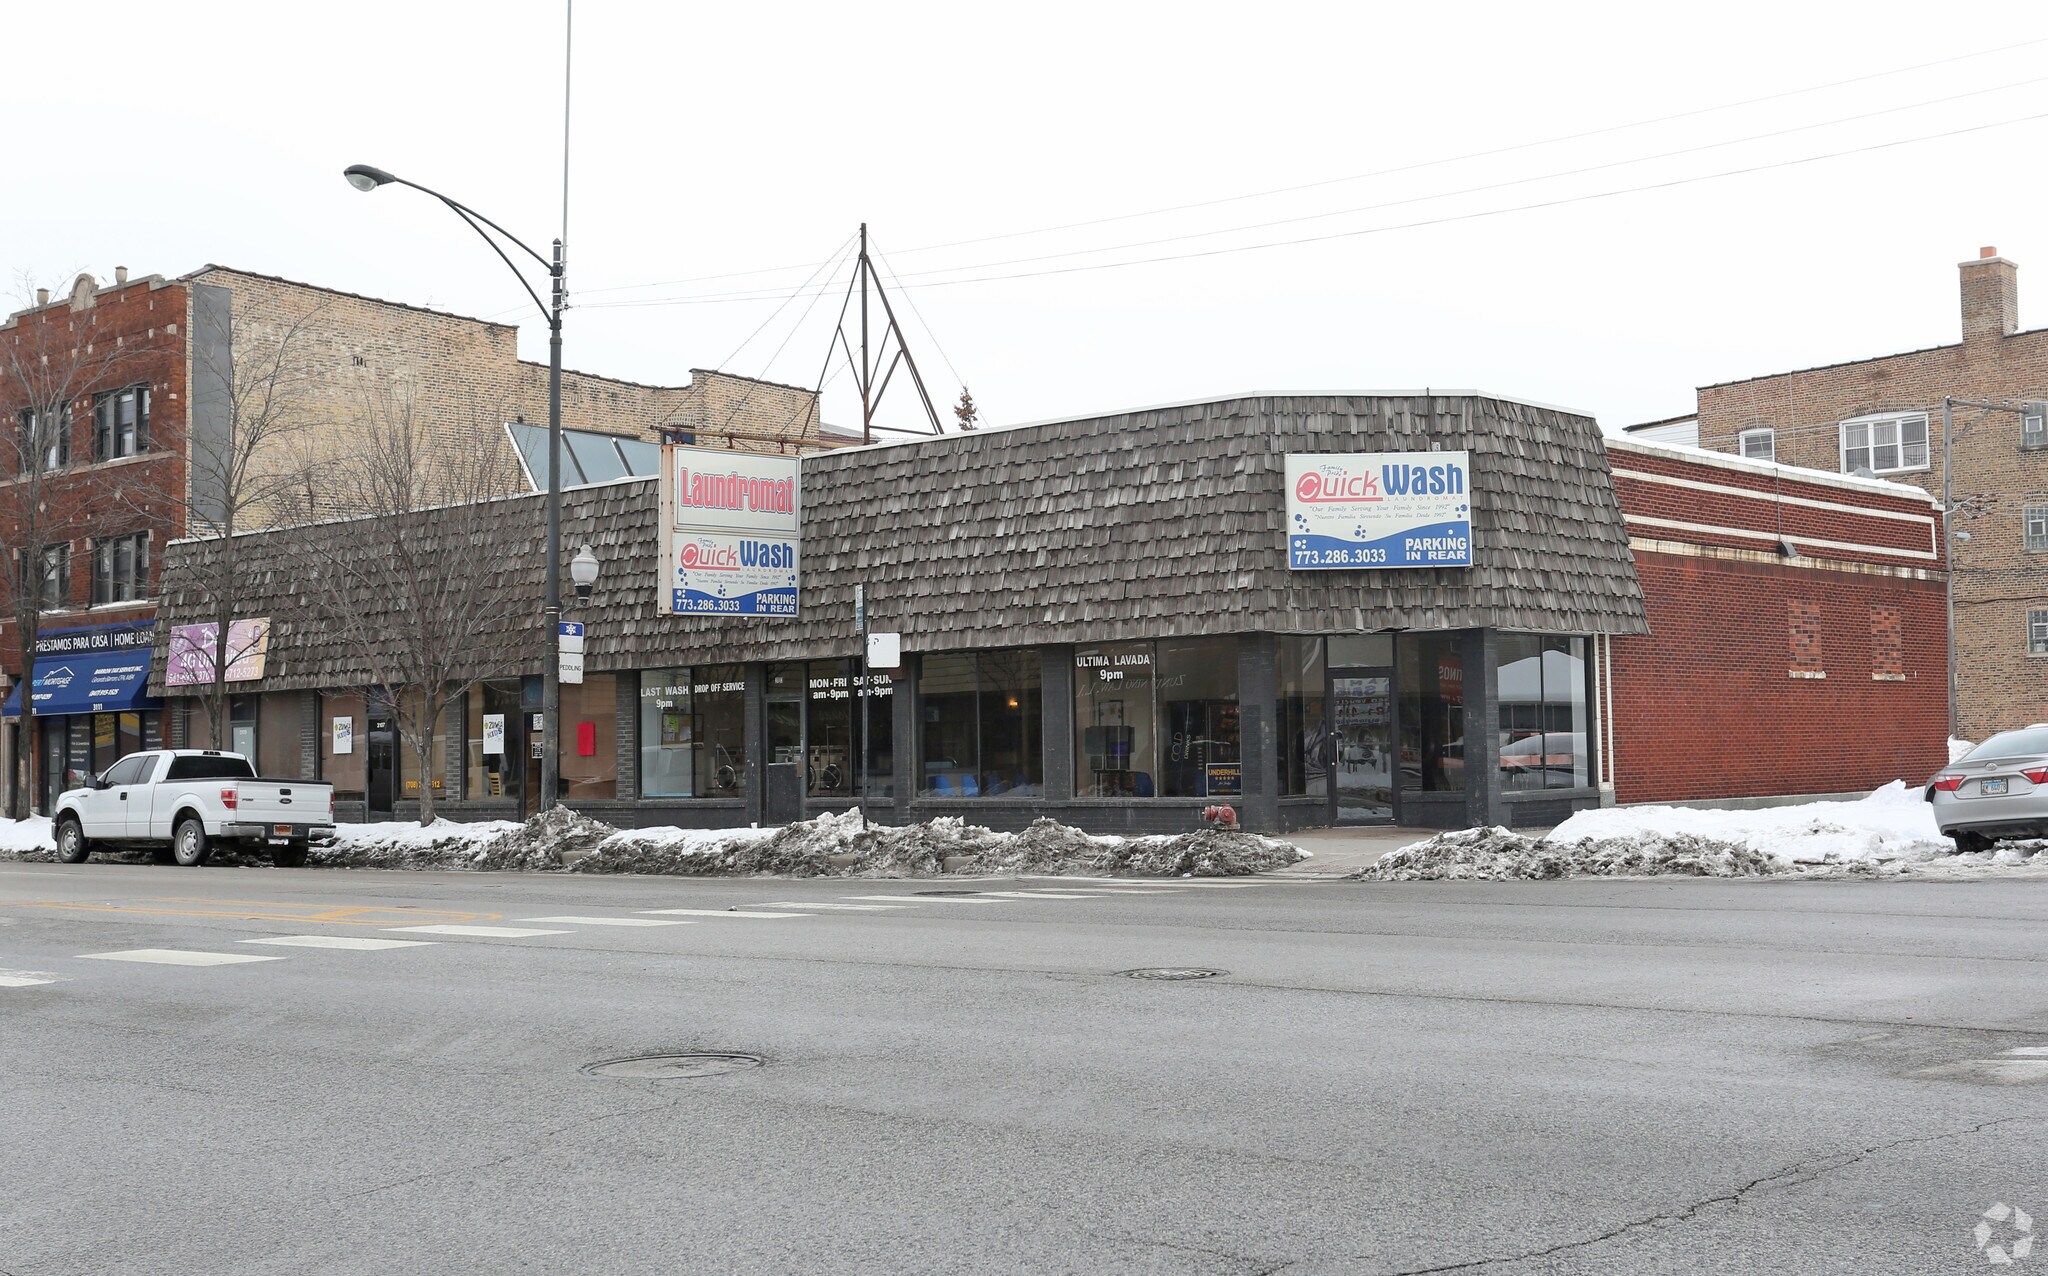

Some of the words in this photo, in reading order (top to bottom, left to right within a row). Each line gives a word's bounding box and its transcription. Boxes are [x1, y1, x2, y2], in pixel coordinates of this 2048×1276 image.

[1296, 471, 1383, 503] Quick
[1382, 464, 1463, 495] Wash
[680, 467, 795, 514] Laundromat
[1405, 538, 1467, 551] PARKING
[680, 543, 741, 571] Quick
[740, 541, 793, 568] Wash
[1295, 549, 1386, 564] 773.286.3033
[1406, 551, 1420, 560] IN
[1428, 551, 1467, 560] REAR
[676, 599, 740, 611] 773.286.3033
[756, 593, 796, 605] PARKING
[756, 604, 766, 612] IN
[770, 605, 795, 613] REAR
[73, 637, 89, 649] PARA
[91, 635, 108, 648] CASA
[114, 632, 135, 646] HOME
[1076, 655, 1110, 667] ULTIMA
[1114, 654, 1150, 666] LAVADA
[1100, 669, 1124, 682] 9pm
[640, 686, 661, 698] LAST
[665, 685, 689, 696] WASH
[694, 683, 709, 694] DROP
[711, 682, 721, 692] OFF
[722, 681, 745, 691] SERVICE
[656, 699, 673, 709] 9pm
[1171, 731, 1183, 762] COLD
